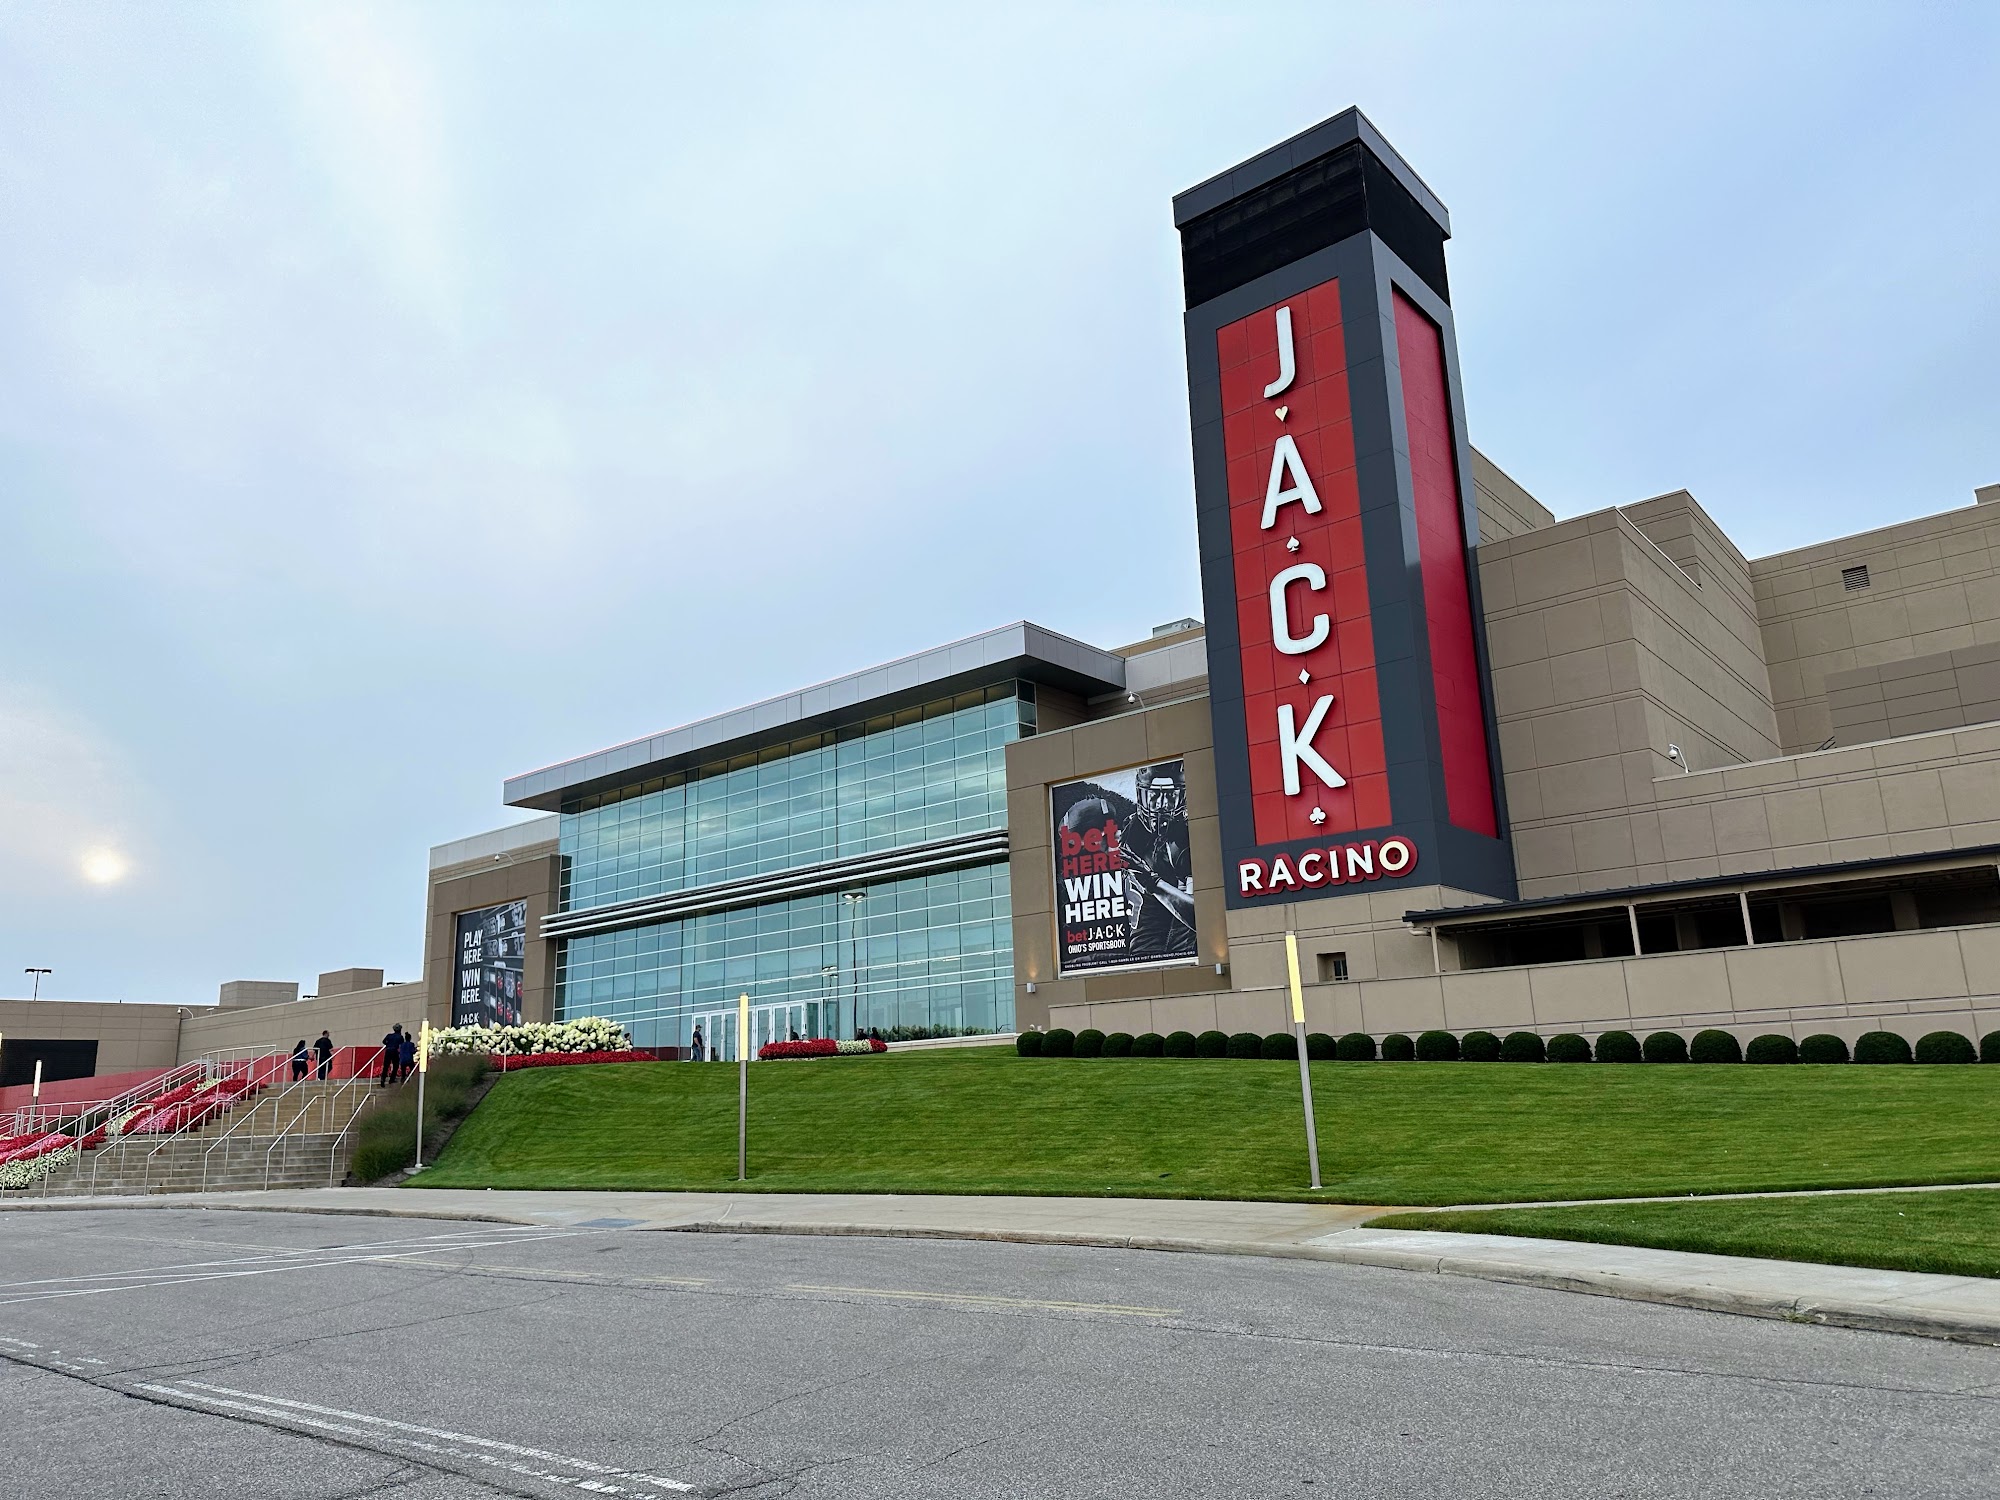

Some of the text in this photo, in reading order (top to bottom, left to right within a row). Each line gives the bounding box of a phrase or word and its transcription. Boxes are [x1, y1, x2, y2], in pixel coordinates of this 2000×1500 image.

[1060, 818, 1119, 857] bet
[1063, 851, 1129, 878] HERE.
[1239, 840, 1410, 892] RACINO
[1064, 871, 1123, 903] WIN
[1064, 897, 1133, 924] HERE.
[464, 929, 483, 949] PLAY
[1068, 938, 1126, 954] OHIO'S SPORTSBOOK
[463, 948, 483, 965] HERE.
[462, 968, 481, 988] WIN
[461, 988, 481, 1004] HERE.
